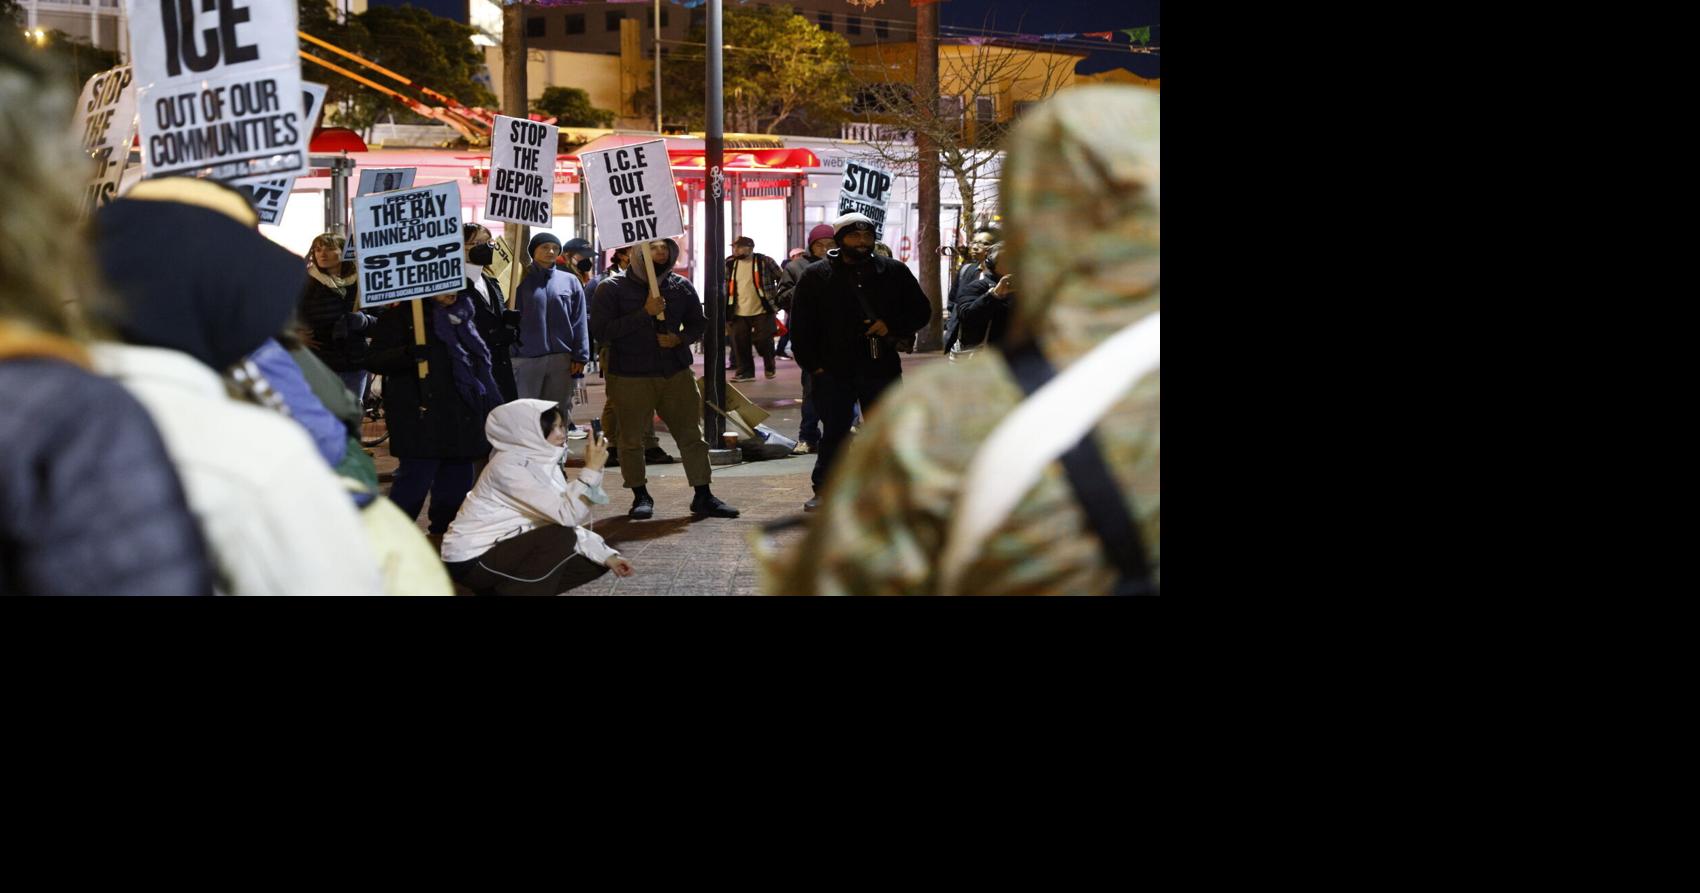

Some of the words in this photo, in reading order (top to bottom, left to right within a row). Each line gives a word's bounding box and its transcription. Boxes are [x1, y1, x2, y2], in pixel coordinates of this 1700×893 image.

[160, 0, 259, 77] ICE
[88, 70, 132, 112] STOP
[155, 93, 197, 130] OUT
[201, 87, 225, 122] OF
[230, 79, 279, 116] OUR
[150, 113, 298, 167] COMMUNITIES
[510, 120, 547, 147] STOP
[513, 146, 540, 171] THE
[603, 147, 648, 173] I.C.E
[495, 168, 548, 198] DEPOR-
[609, 171, 644, 196] OUT
[844, 163, 890, 201] STOP
[370, 202, 407, 227] THE
[410, 194, 447, 219] BAY
[386, 191, 431, 204] FROM
[490, 192, 549, 224] TATIONS
[617, 194, 655, 219] THE
[840, 196, 854, 210] ICE
[855, 201, 886, 223] TERROR
[360, 217, 457, 249] MINNEAPOLIS
[399, 218, 421, 226] TO
[621, 217, 658, 244] BAY
[364, 242, 461, 269] STOP
[365, 269, 393, 291] ICE
[396, 257, 462, 286] TERROR
[367, 292, 385, 301] PARTY
